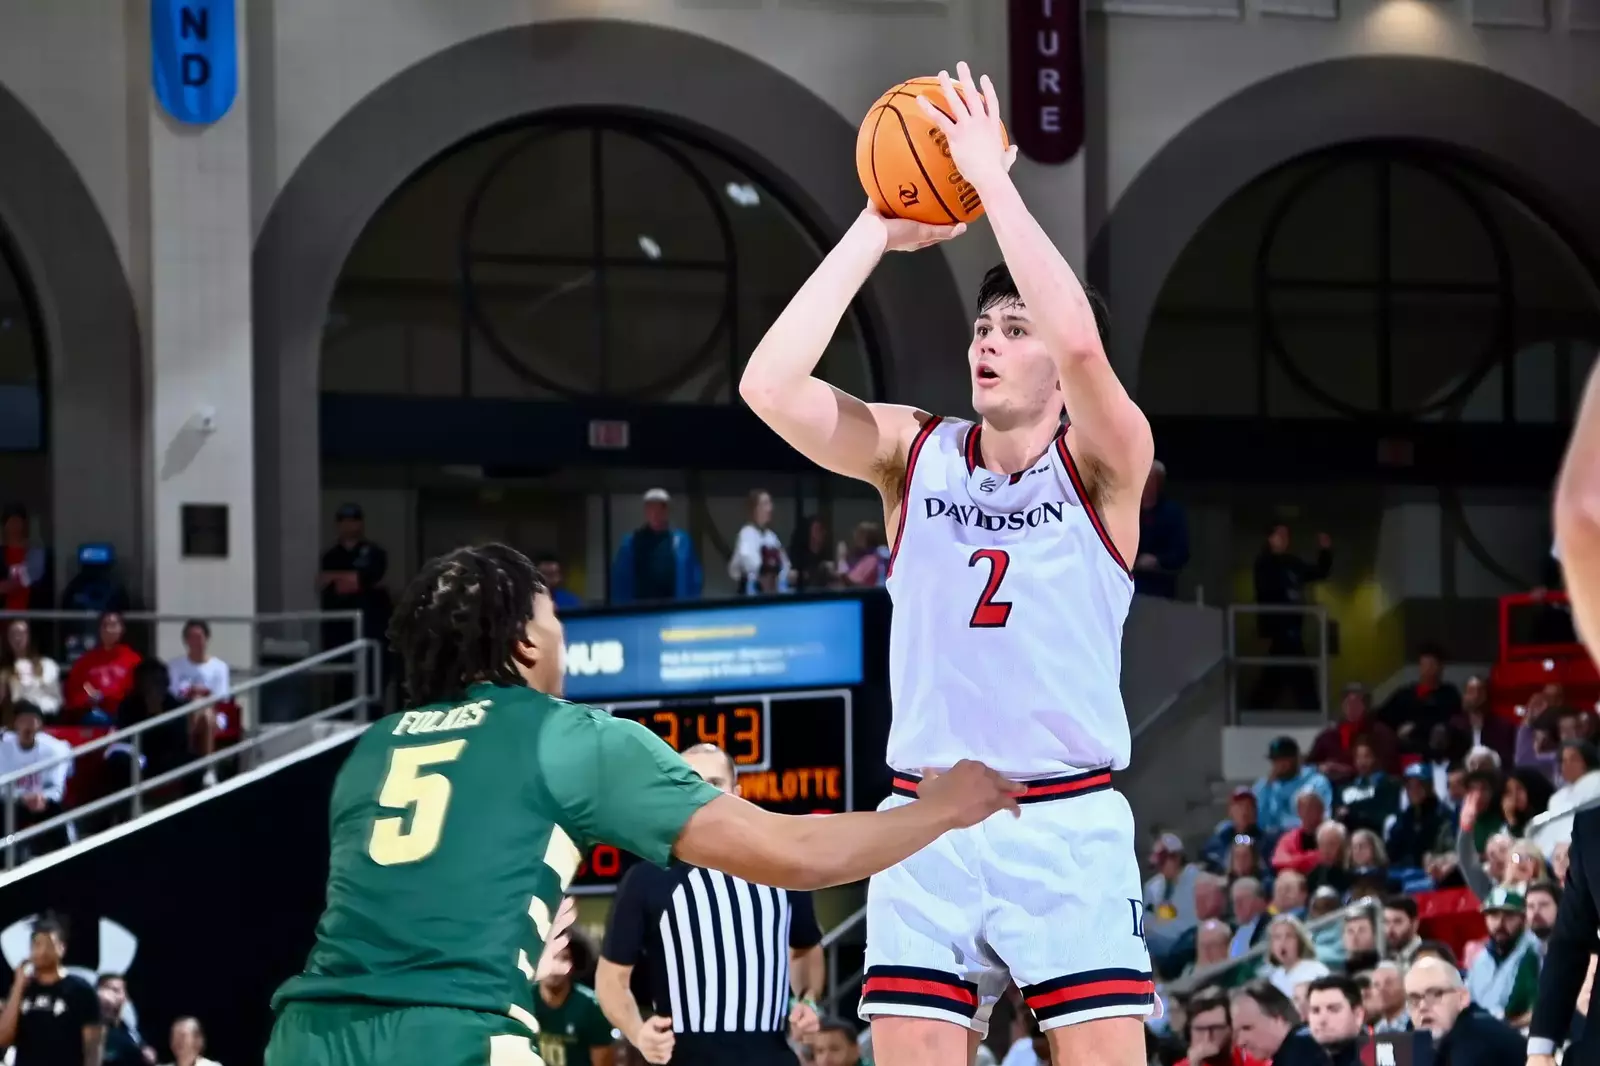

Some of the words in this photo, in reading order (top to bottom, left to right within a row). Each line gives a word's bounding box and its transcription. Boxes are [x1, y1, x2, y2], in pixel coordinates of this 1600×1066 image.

[924, 497, 1066, 532] DAVIDSON
[968, 548, 1013, 628] 2
[638, 708, 760, 765] 3:43
[368, 738, 469, 867] 5
